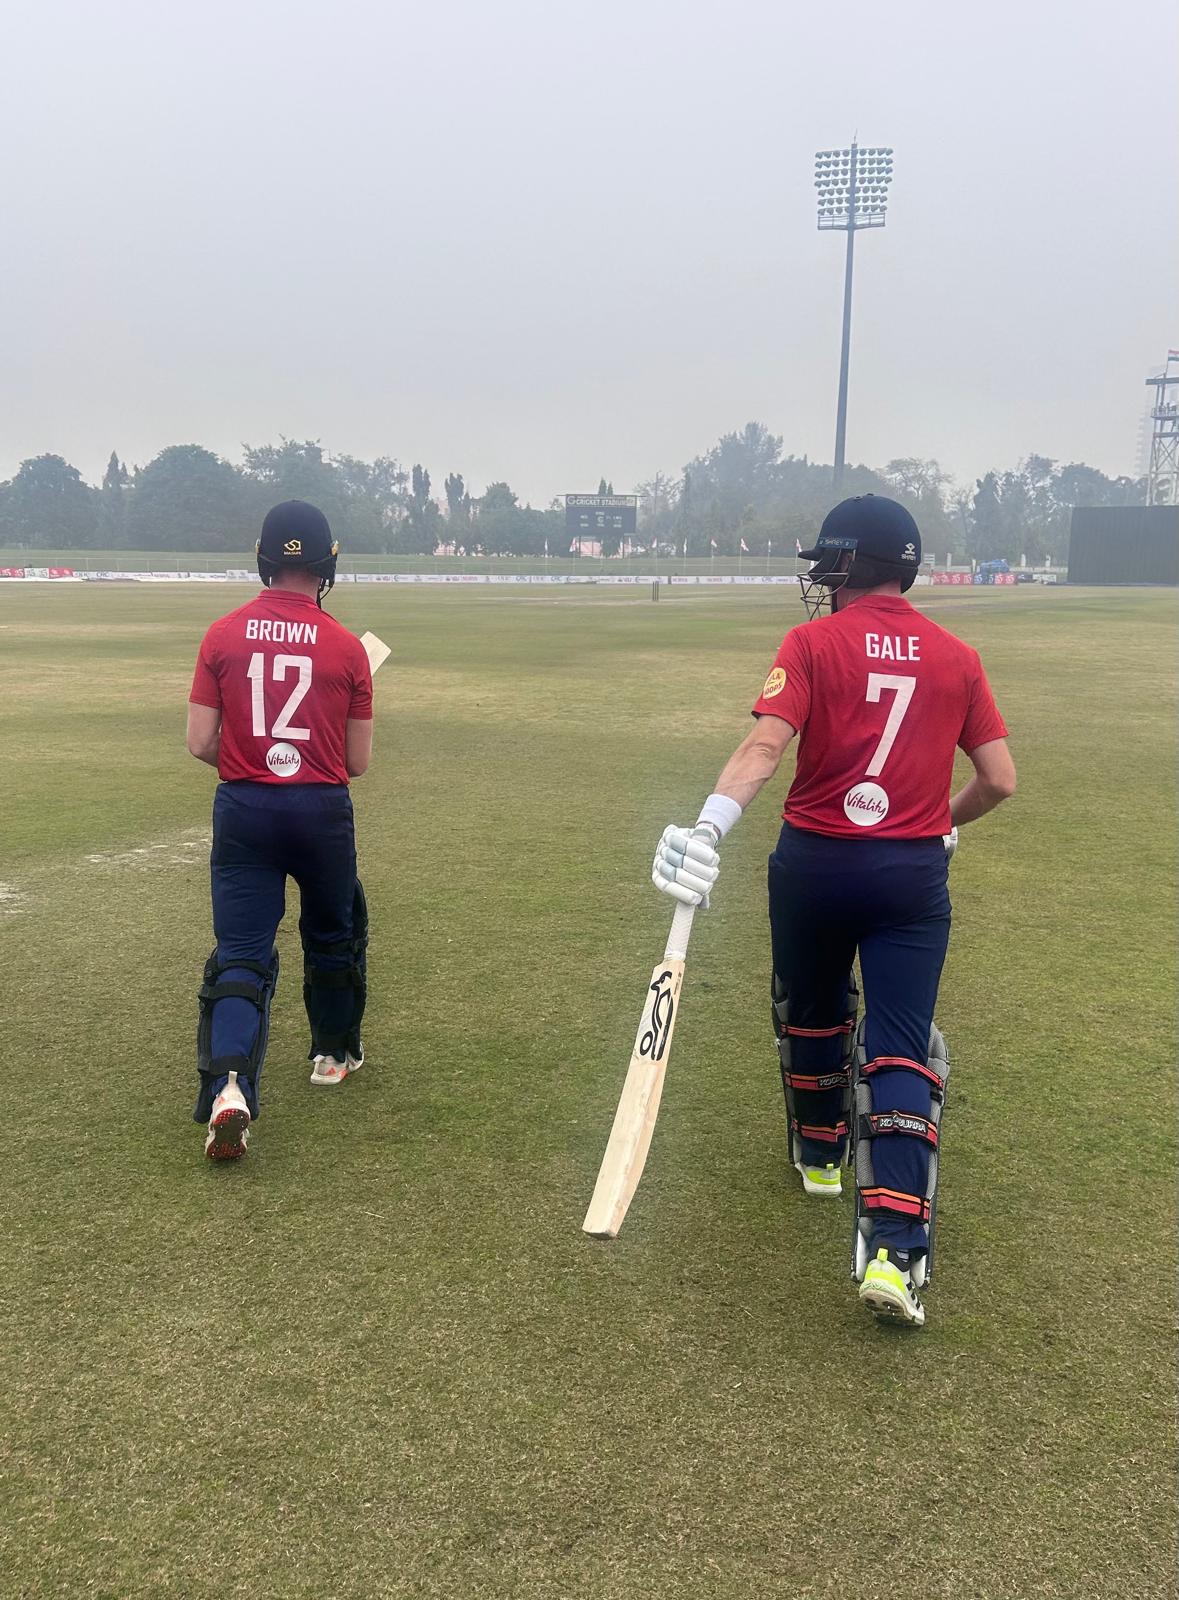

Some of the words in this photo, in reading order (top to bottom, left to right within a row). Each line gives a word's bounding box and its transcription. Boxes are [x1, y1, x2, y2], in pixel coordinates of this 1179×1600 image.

[246, 619, 317, 645] BROWN
[865, 632, 921, 661] GALE
[247, 652, 313, 740] 12
[864, 672, 917, 777] 7
[267, 753, 300, 768] Vitality
[846, 791, 887, 819] Vitality
